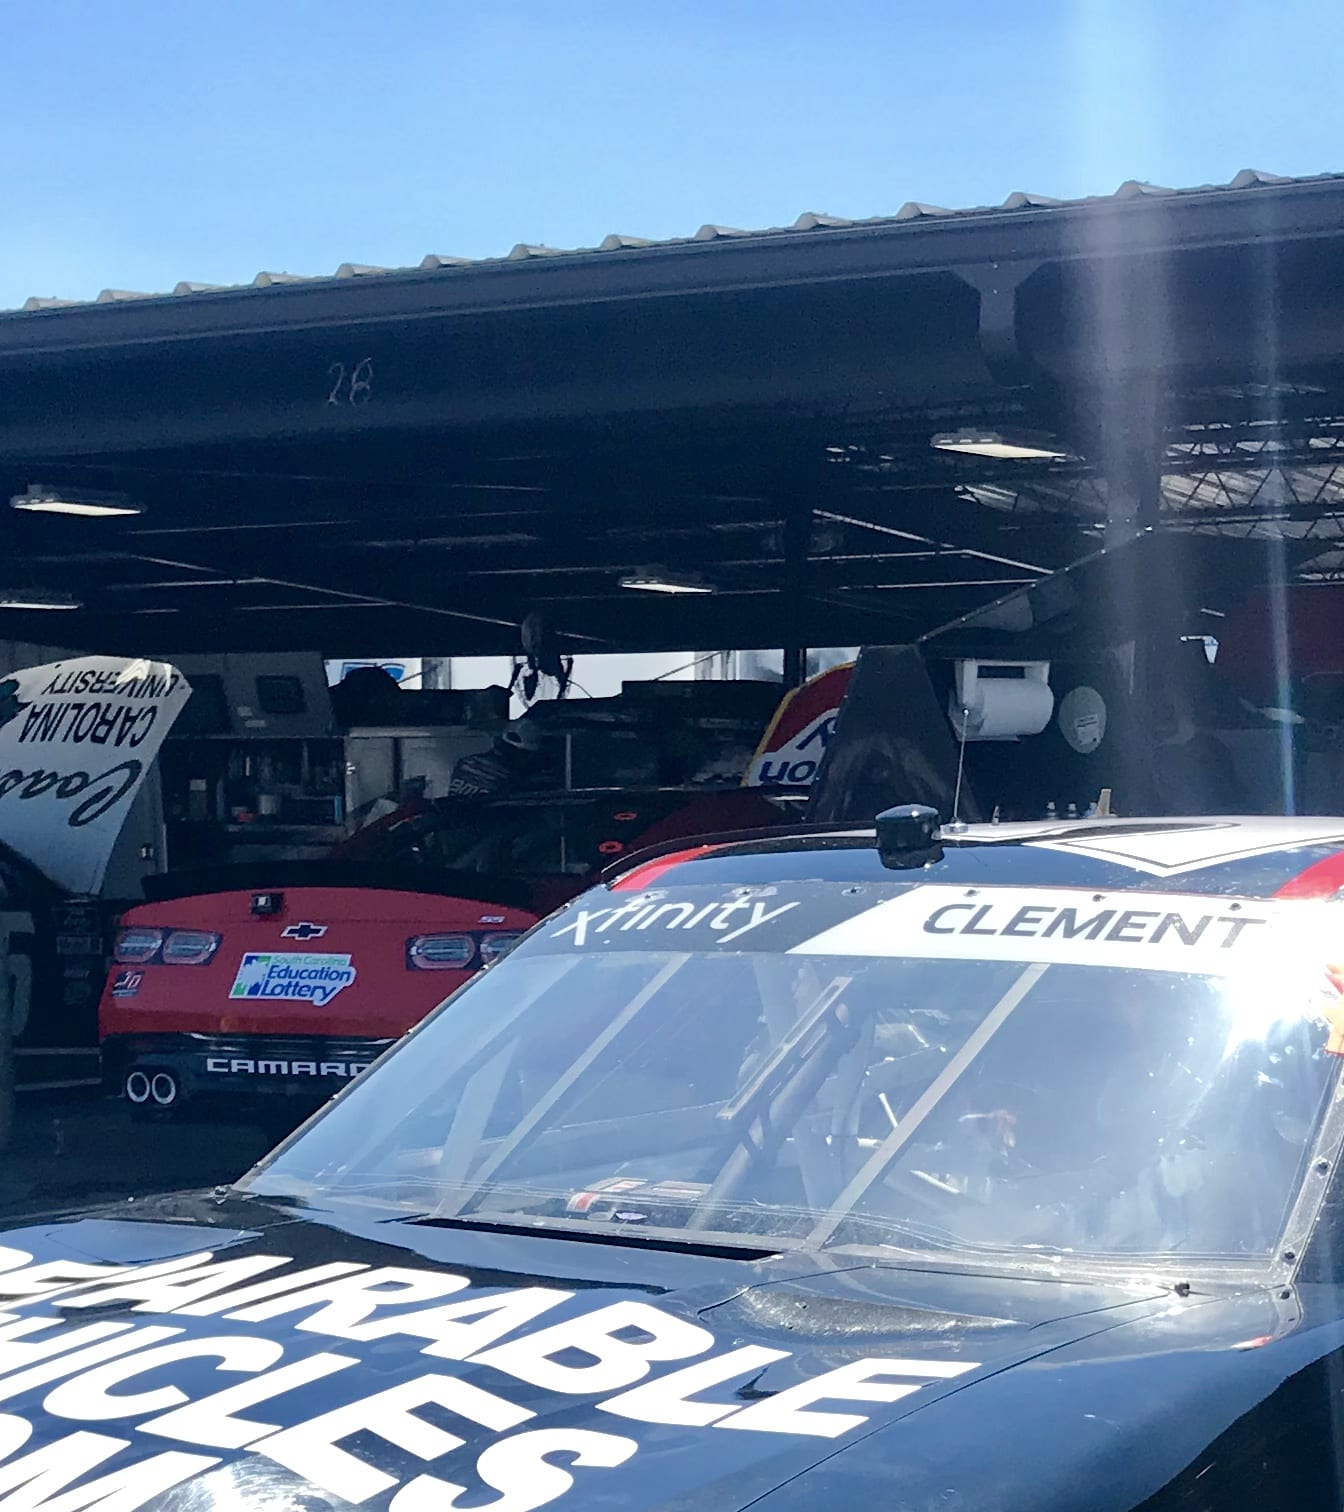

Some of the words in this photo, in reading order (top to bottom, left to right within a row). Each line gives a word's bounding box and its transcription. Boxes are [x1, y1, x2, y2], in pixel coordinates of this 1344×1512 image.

[18, 702, 158, 748] CAROLINA
[549, 895, 802, 947] xfinity
[272, 955, 304, 965] South
[305, 955, 348, 966] Carolina
[266, 964, 352, 983] Education
[259, 979, 337, 1001] Lottery
